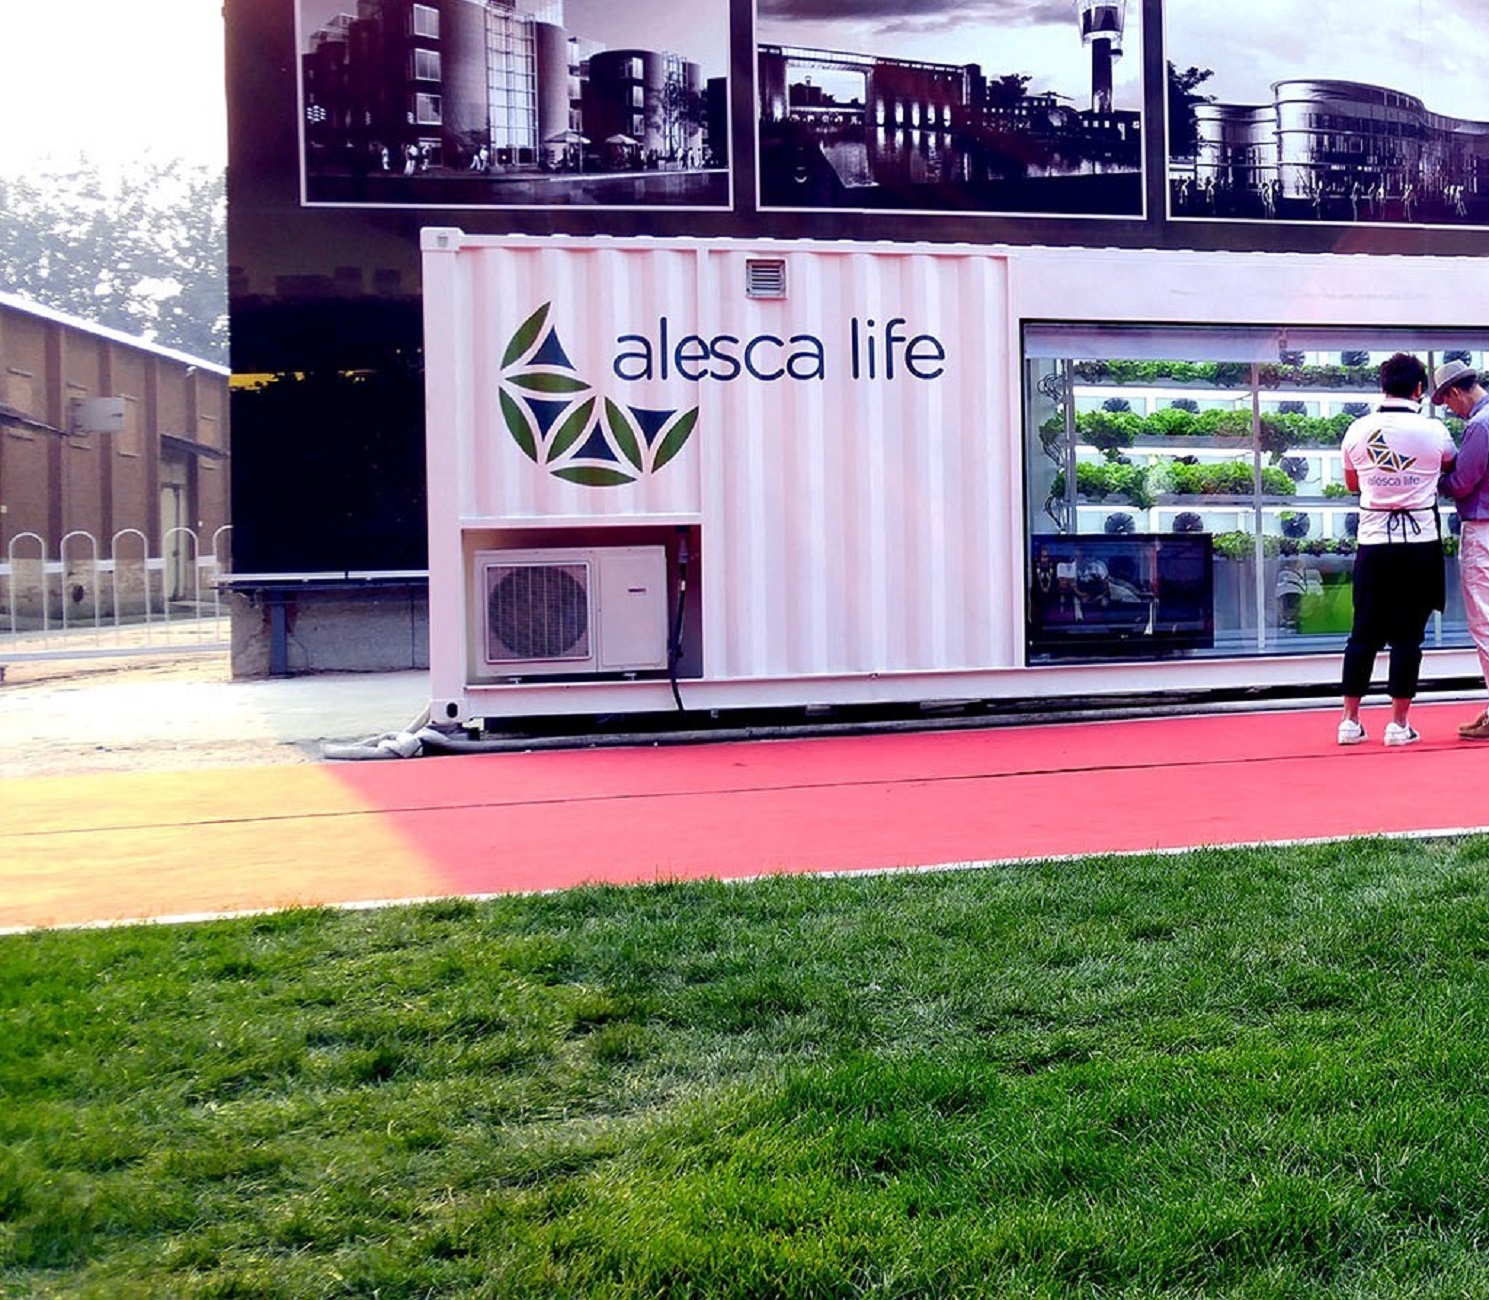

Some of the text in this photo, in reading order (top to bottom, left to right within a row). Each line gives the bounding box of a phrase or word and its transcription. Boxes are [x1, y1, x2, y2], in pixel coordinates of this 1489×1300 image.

[613, 316, 946, 382] alesca life
[1367, 475, 1420, 487] alesca life
